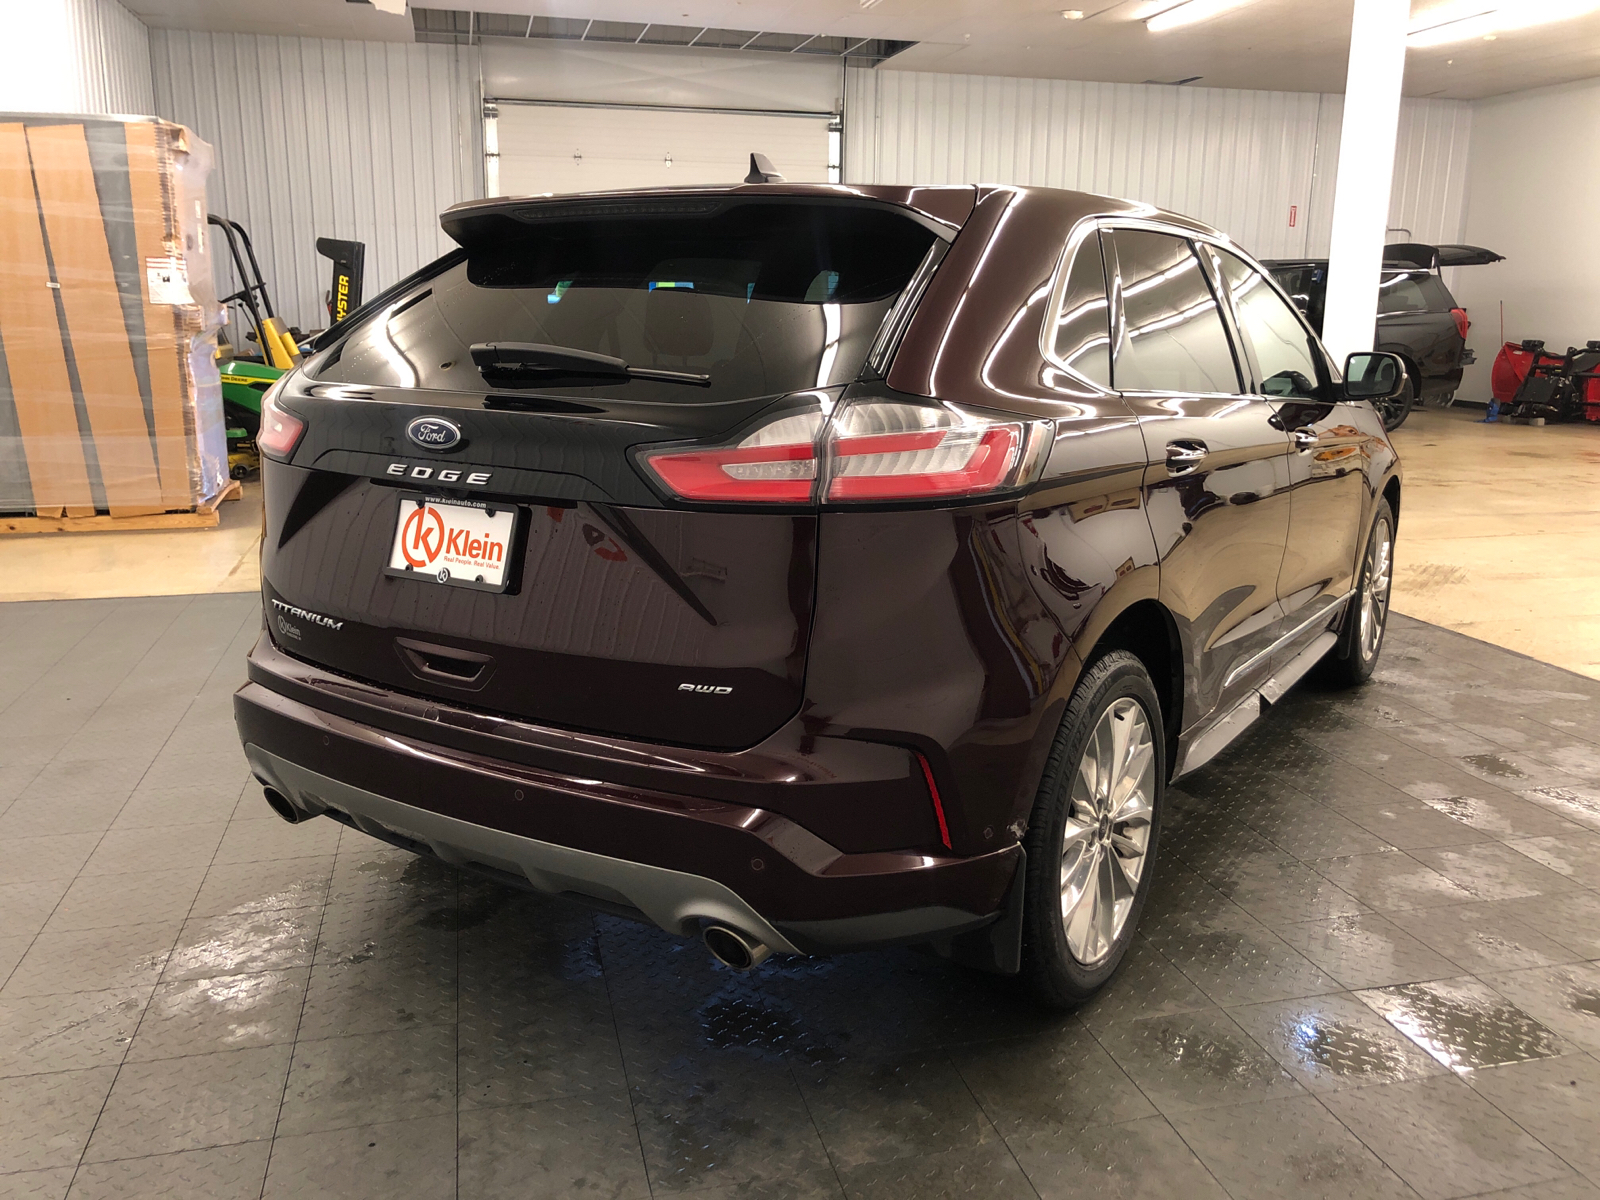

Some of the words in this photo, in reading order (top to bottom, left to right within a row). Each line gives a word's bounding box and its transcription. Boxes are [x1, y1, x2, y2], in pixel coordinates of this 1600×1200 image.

[418, 423, 446, 443] Ford
[386, 463, 492, 486] EDGE
[425, 496, 487, 509] www.kleinauto.com
[445, 527, 503, 562] Klein
[443, 555, 455, 563] Real
[473, 560, 485, 568] Real
[271, 598, 343, 631] TITANIUM
[677, 683, 733, 695] AWD
